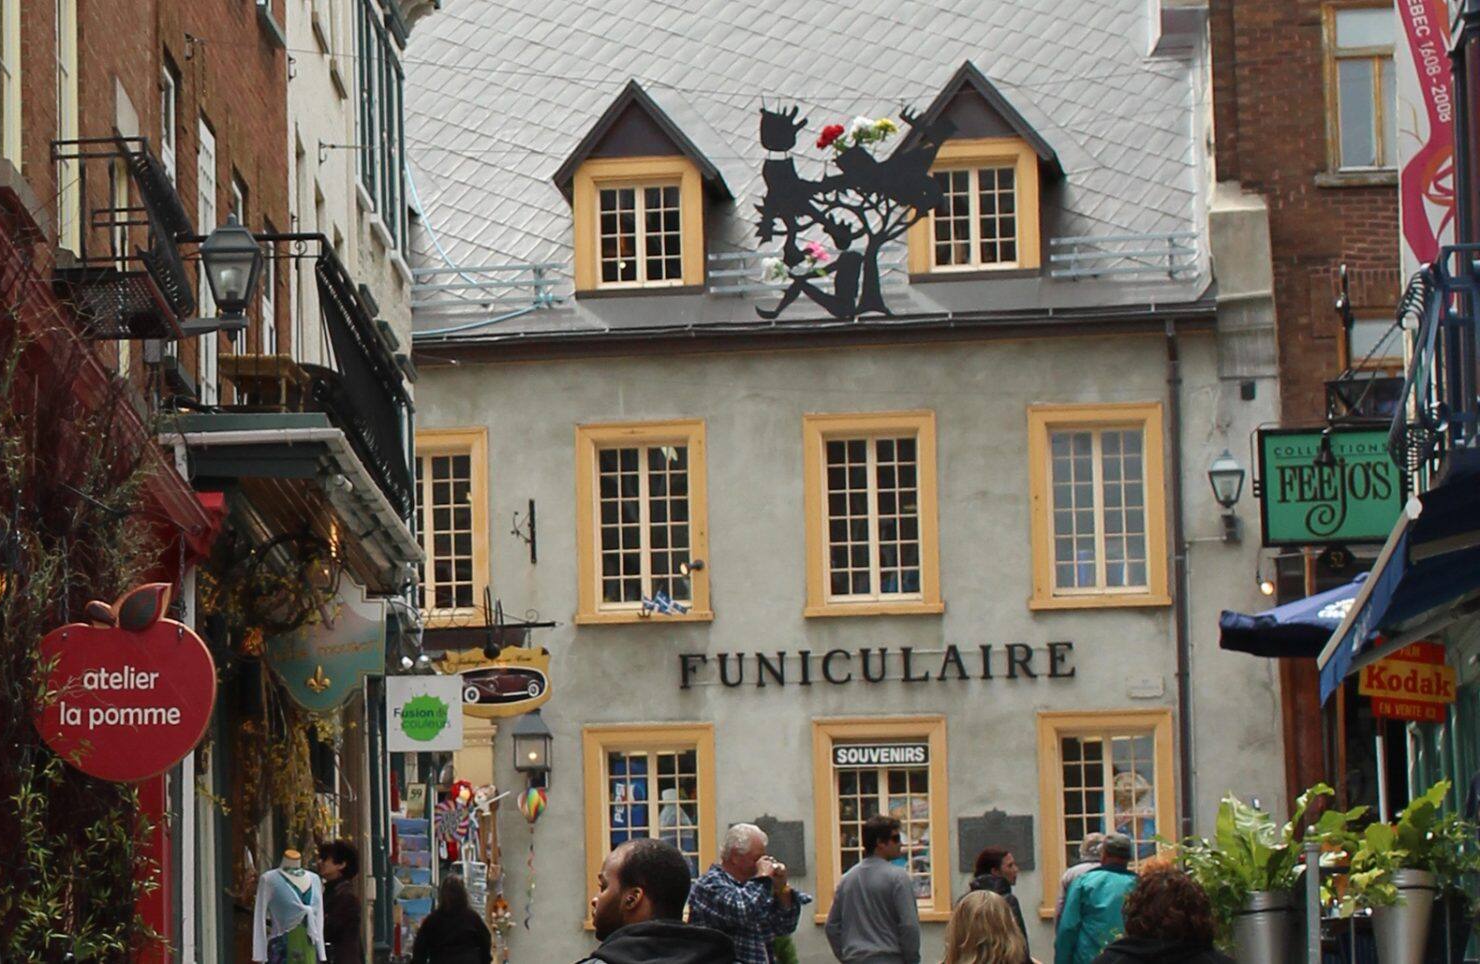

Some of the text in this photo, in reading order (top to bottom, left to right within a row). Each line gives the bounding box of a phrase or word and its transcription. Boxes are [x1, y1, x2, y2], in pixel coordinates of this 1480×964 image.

[1419, 40, 1441, 76] 1608
[1274, 443, 1389, 456] COLLTIONS
[83, 665, 160, 690] atelier
[678, 641, 1077, 689] FUNICULAIRE
[1365, 664, 1452, 697] Kodak
[60, 701, 181, 730] la pomme
[394, 707, 434, 718] Fusion
[836, 746, 925, 764] SOUVENIRS
[614, 782, 625, 823] PEPSI
